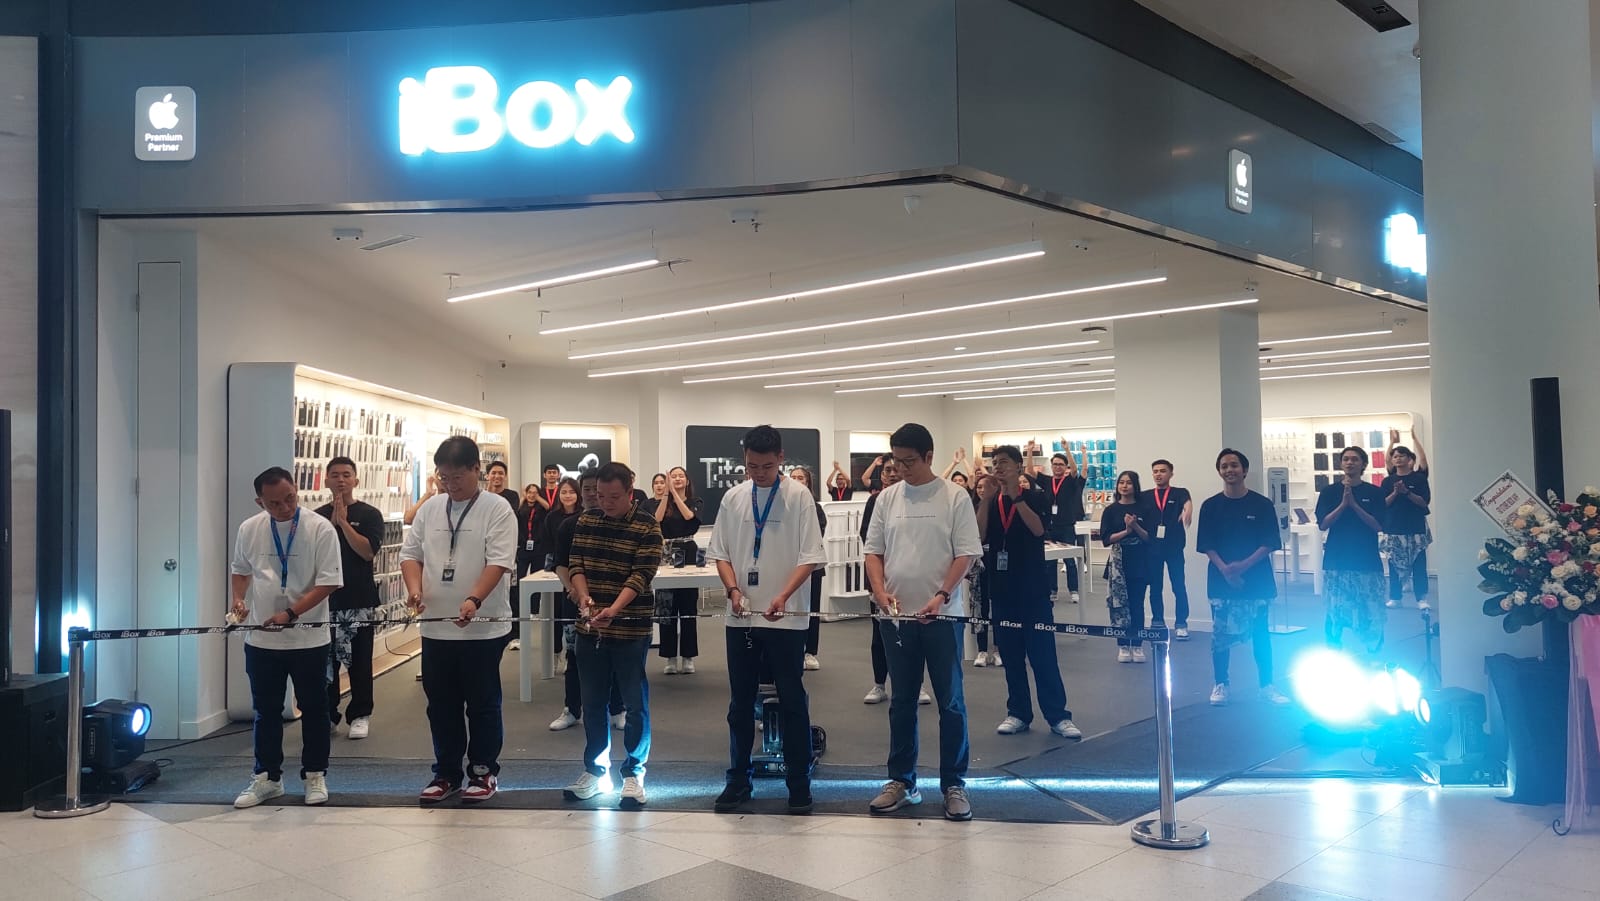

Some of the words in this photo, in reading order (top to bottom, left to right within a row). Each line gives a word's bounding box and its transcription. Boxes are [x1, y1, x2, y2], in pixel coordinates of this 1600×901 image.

[398, 65, 635, 156] iBox
[145, 133, 183, 142] Premium
[148, 143, 180, 152] Partner
[93, 631, 111, 639] iBox
[121, 630, 140, 638] iBox
[968, 617, 991, 626] iBox
[1000, 620, 1022, 629] iBox
[1034, 622, 1057, 632] iBox
[1065, 624, 1089, 634] iBox
[1103, 627, 1127, 637] iBox
[1137, 630, 1161, 639] iBox
